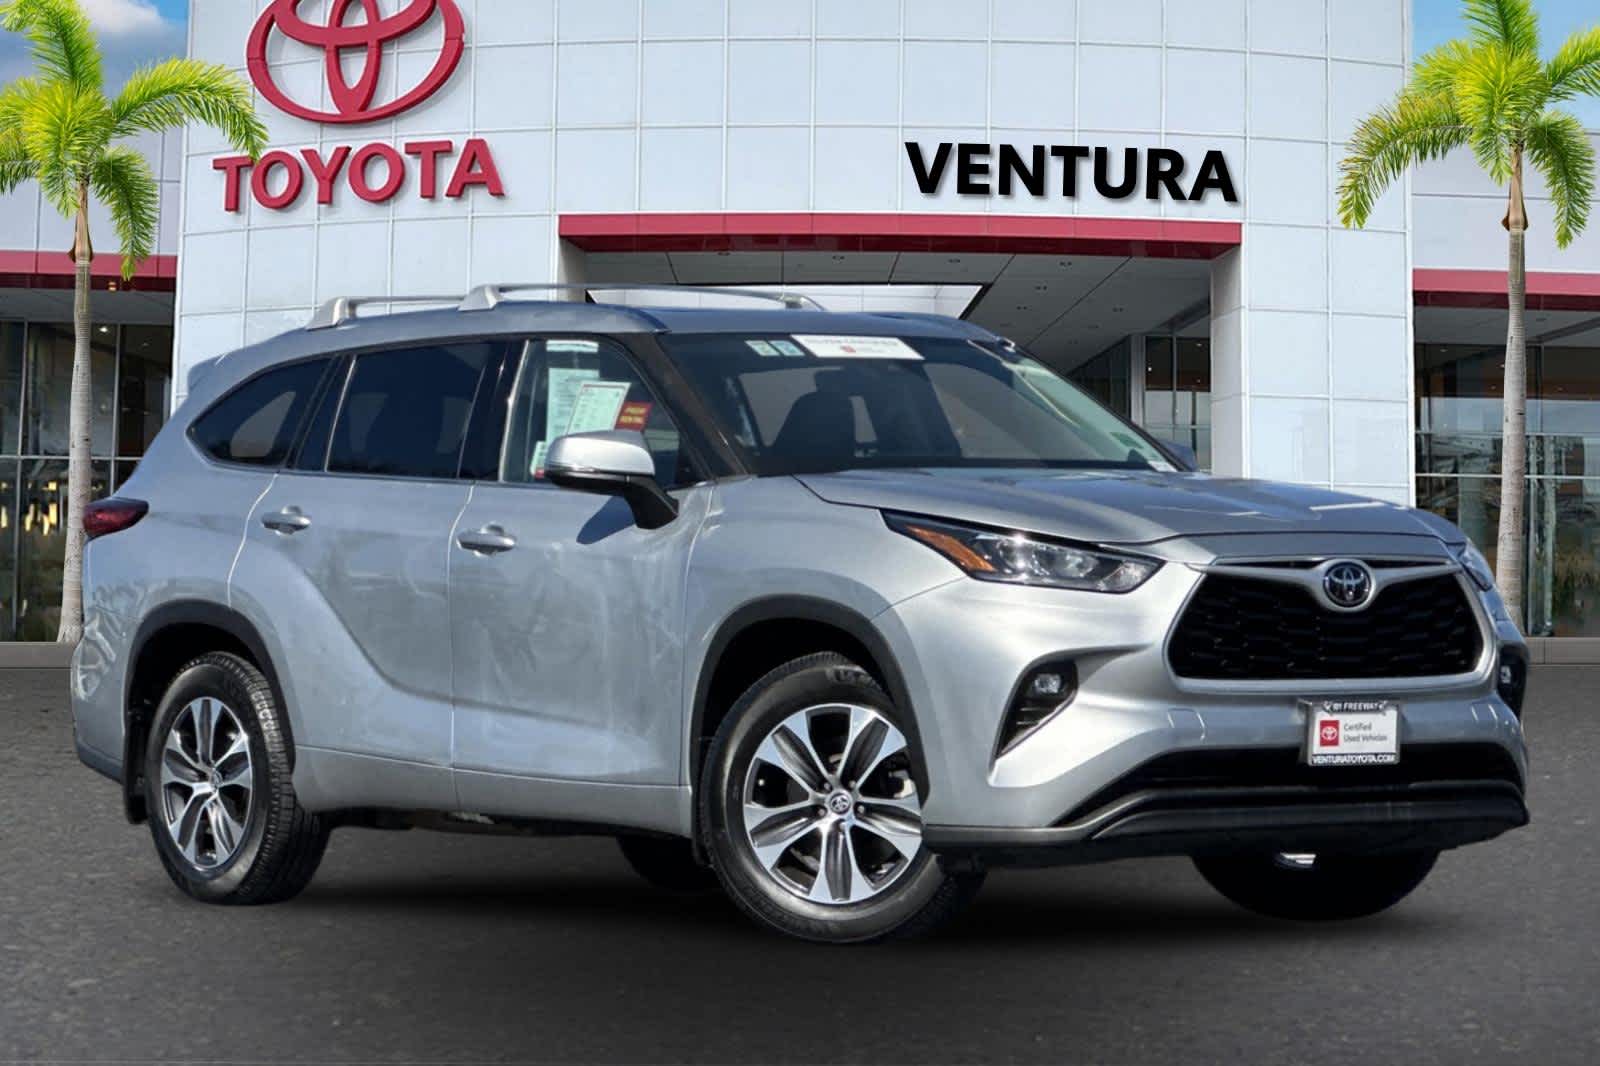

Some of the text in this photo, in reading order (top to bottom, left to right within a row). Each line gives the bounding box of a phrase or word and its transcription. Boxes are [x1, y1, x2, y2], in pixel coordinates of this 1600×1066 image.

[213, 138, 504, 212] TOYOTA
[904, 141, 1239, 203] VENTURA
[1343, 702, 1379, 710] FREEWAY
[1343, 723, 1372, 732] Certified
[1343, 734, 1361, 743] Used
[1313, 755, 1395, 764] VENTURATOYOTA.COM
